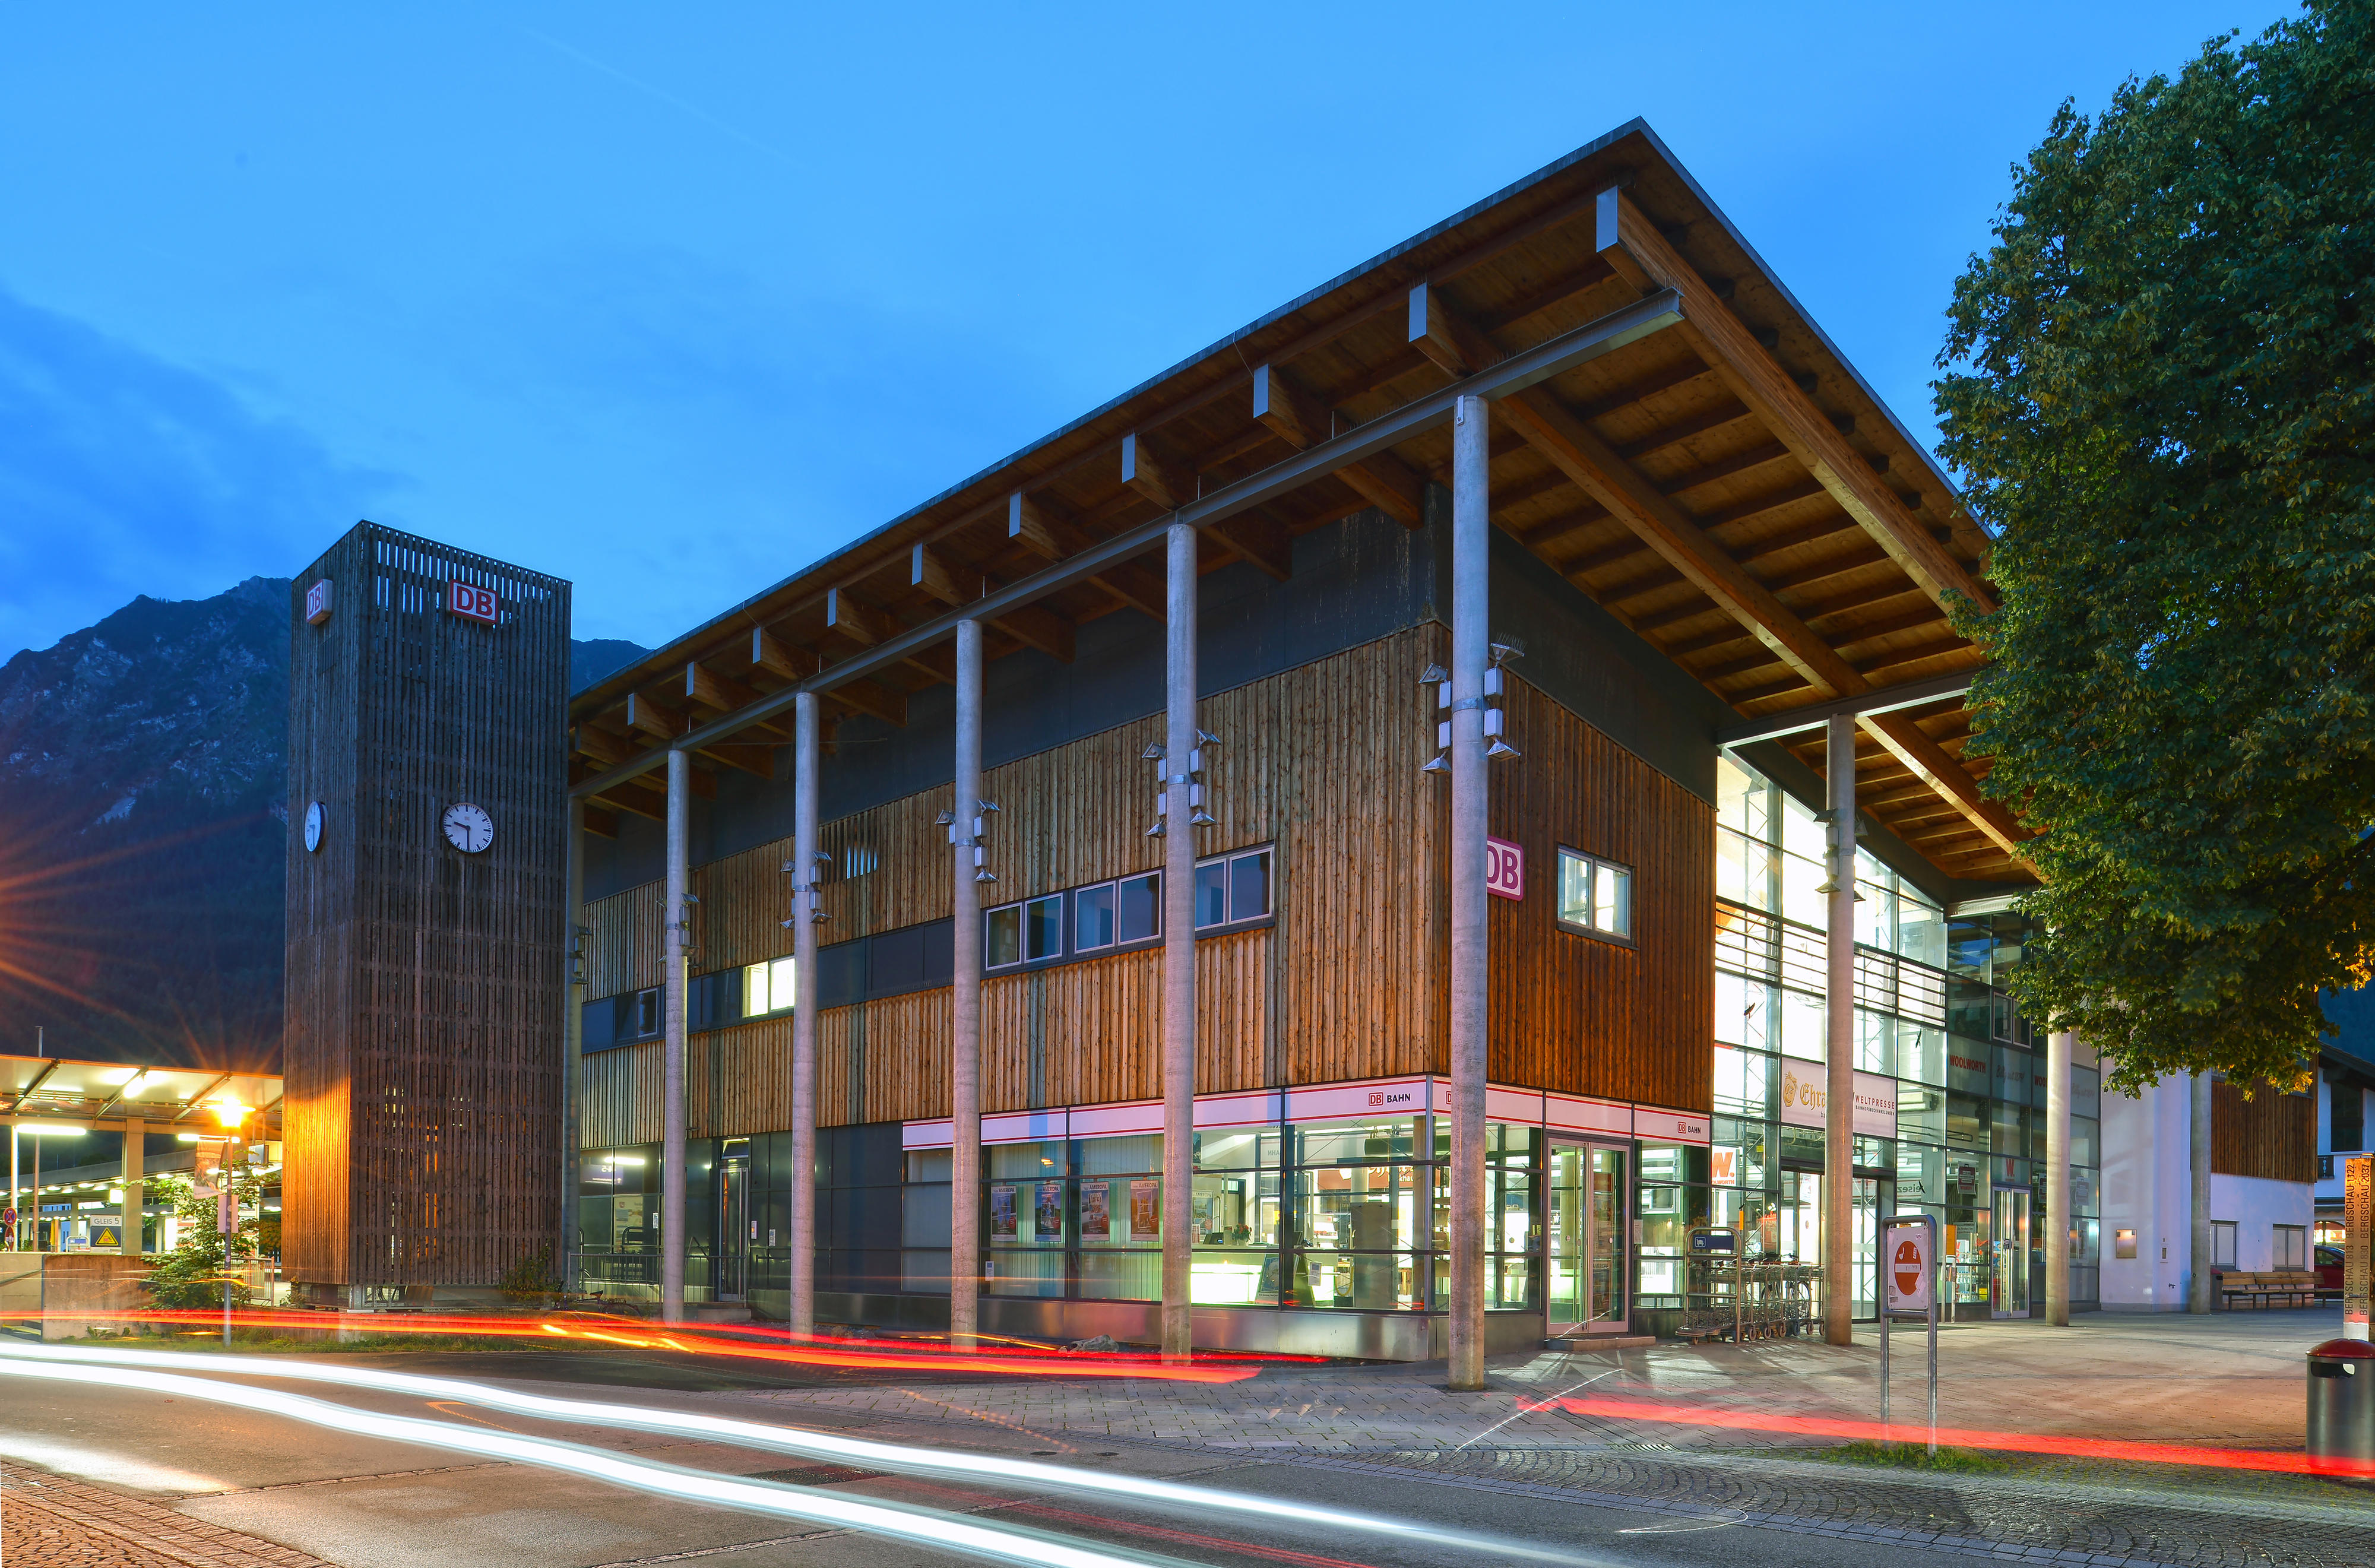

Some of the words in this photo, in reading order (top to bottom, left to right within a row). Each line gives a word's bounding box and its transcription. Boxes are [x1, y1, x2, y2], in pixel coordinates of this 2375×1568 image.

[308, 587, 321, 615] DB
[456, 585, 493, 617] DB
[1487, 844, 1519, 890] DB
[1949, 1054, 1986, 1073] WOOLWORTH
[1370, 1094, 1382, 1104] DB
[1386, 1094, 1411, 1103] BAHN
[1800, 1083, 1826, 1110] Ehra
[1855, 1095, 1895, 1109] WELTPRESSE
[1679, 1123, 1685, 1132] DB
[1687, 1126, 1701, 1134] BAHN
[2361, 1164, 2370, 1182] 2037
[2345, 1185, 2355, 1238] BERGSCHAU
[2360, 1185, 2370, 1238] BERGSCHAU
[2346, 1245, 2354, 1259] 813
[2360, 1245, 2368, 1259] 830
[2345, 1262, 2354, 1315] BERGSCHAU
[2360, 1262, 2368, 1315] BERGSCHAU
